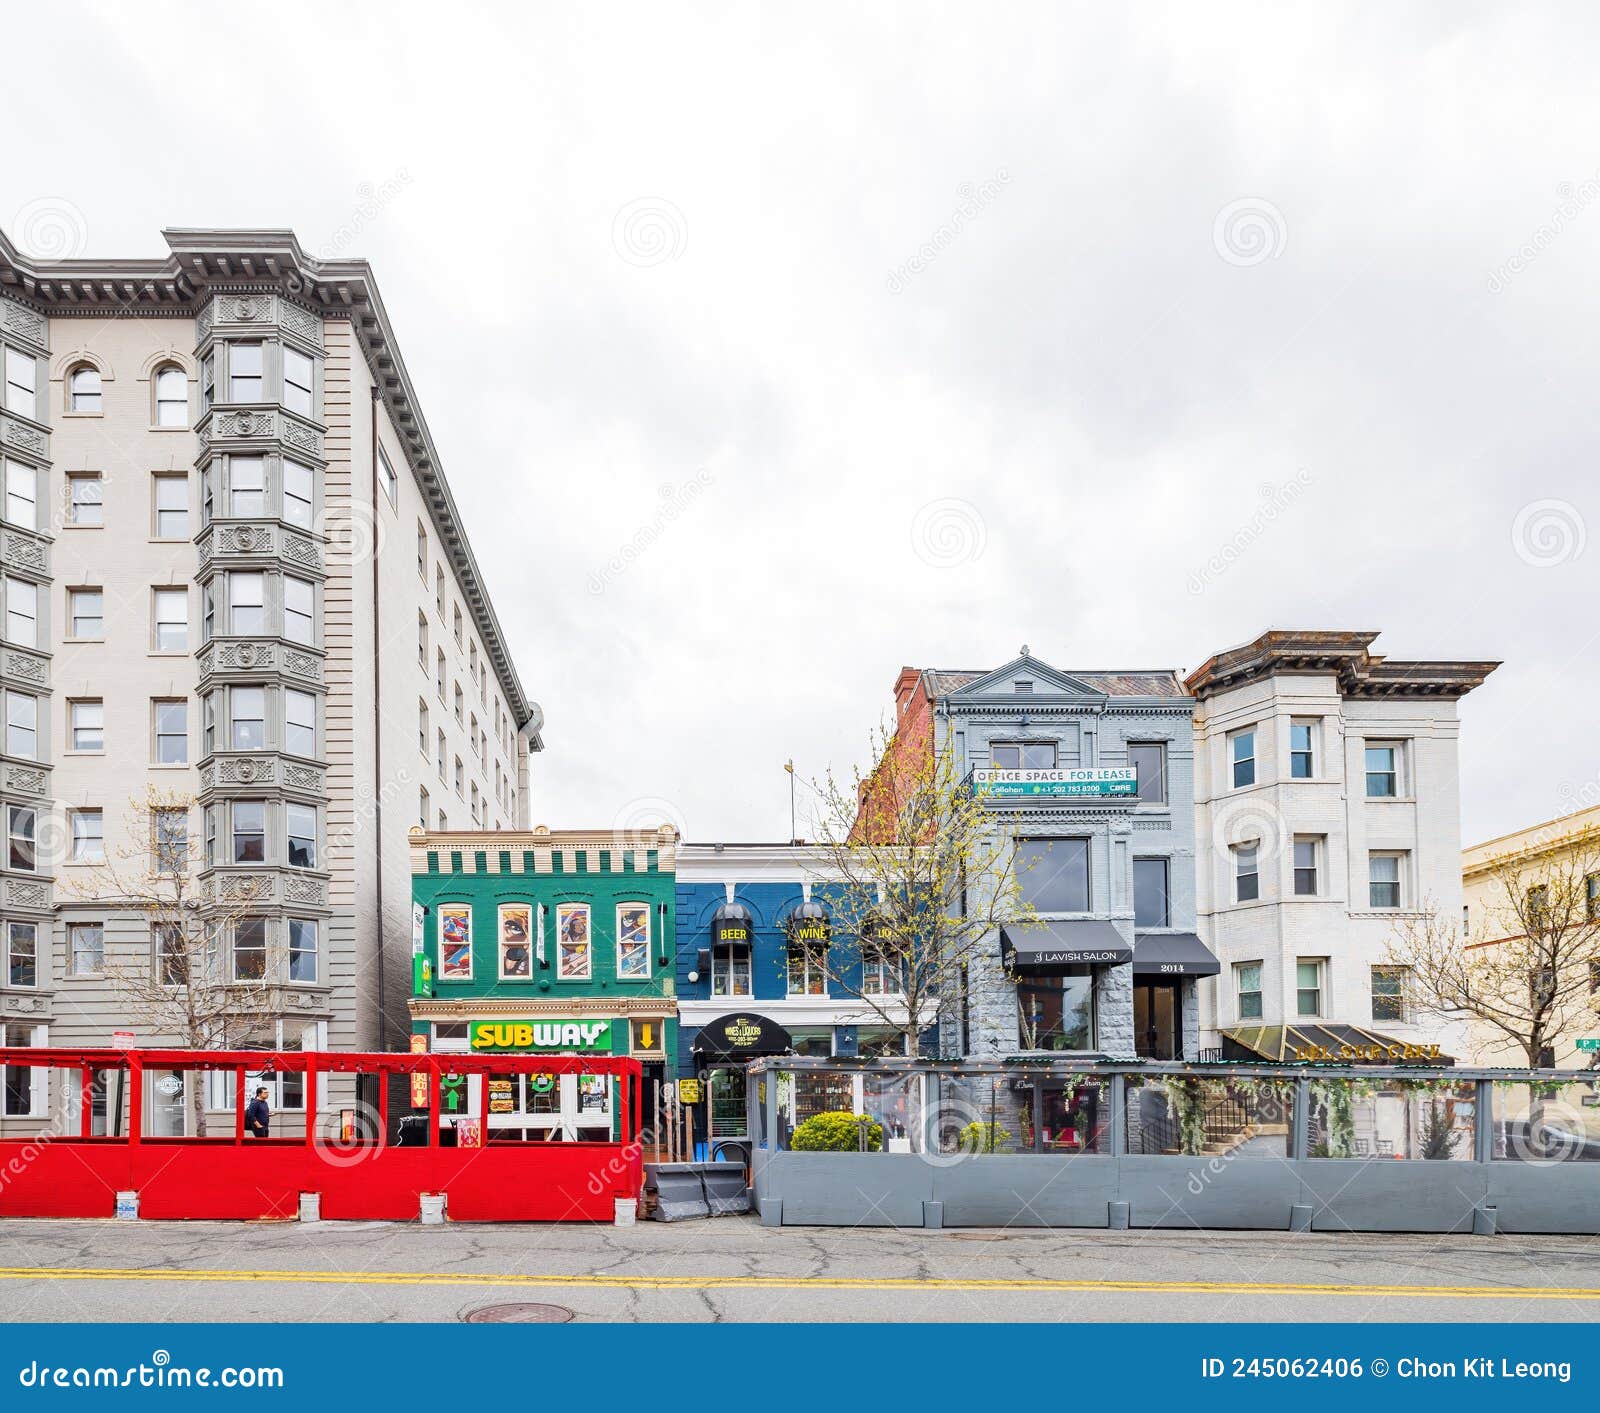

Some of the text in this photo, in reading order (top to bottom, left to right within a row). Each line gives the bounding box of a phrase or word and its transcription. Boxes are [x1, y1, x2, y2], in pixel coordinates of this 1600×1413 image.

[977, 770, 1132, 781] OFFICE SPACE FOR LEASE
[720, 928, 747, 940] BEER
[799, 928, 826, 939] WINE
[1045, 952, 1081, 961] LAVISH
[1083, 952, 1117, 960] SALON
[1160, 964, 1185, 973] 2014
[472, 1022, 609, 1048] SUBWAY
[1340, 1044, 1382, 1060] SUR
